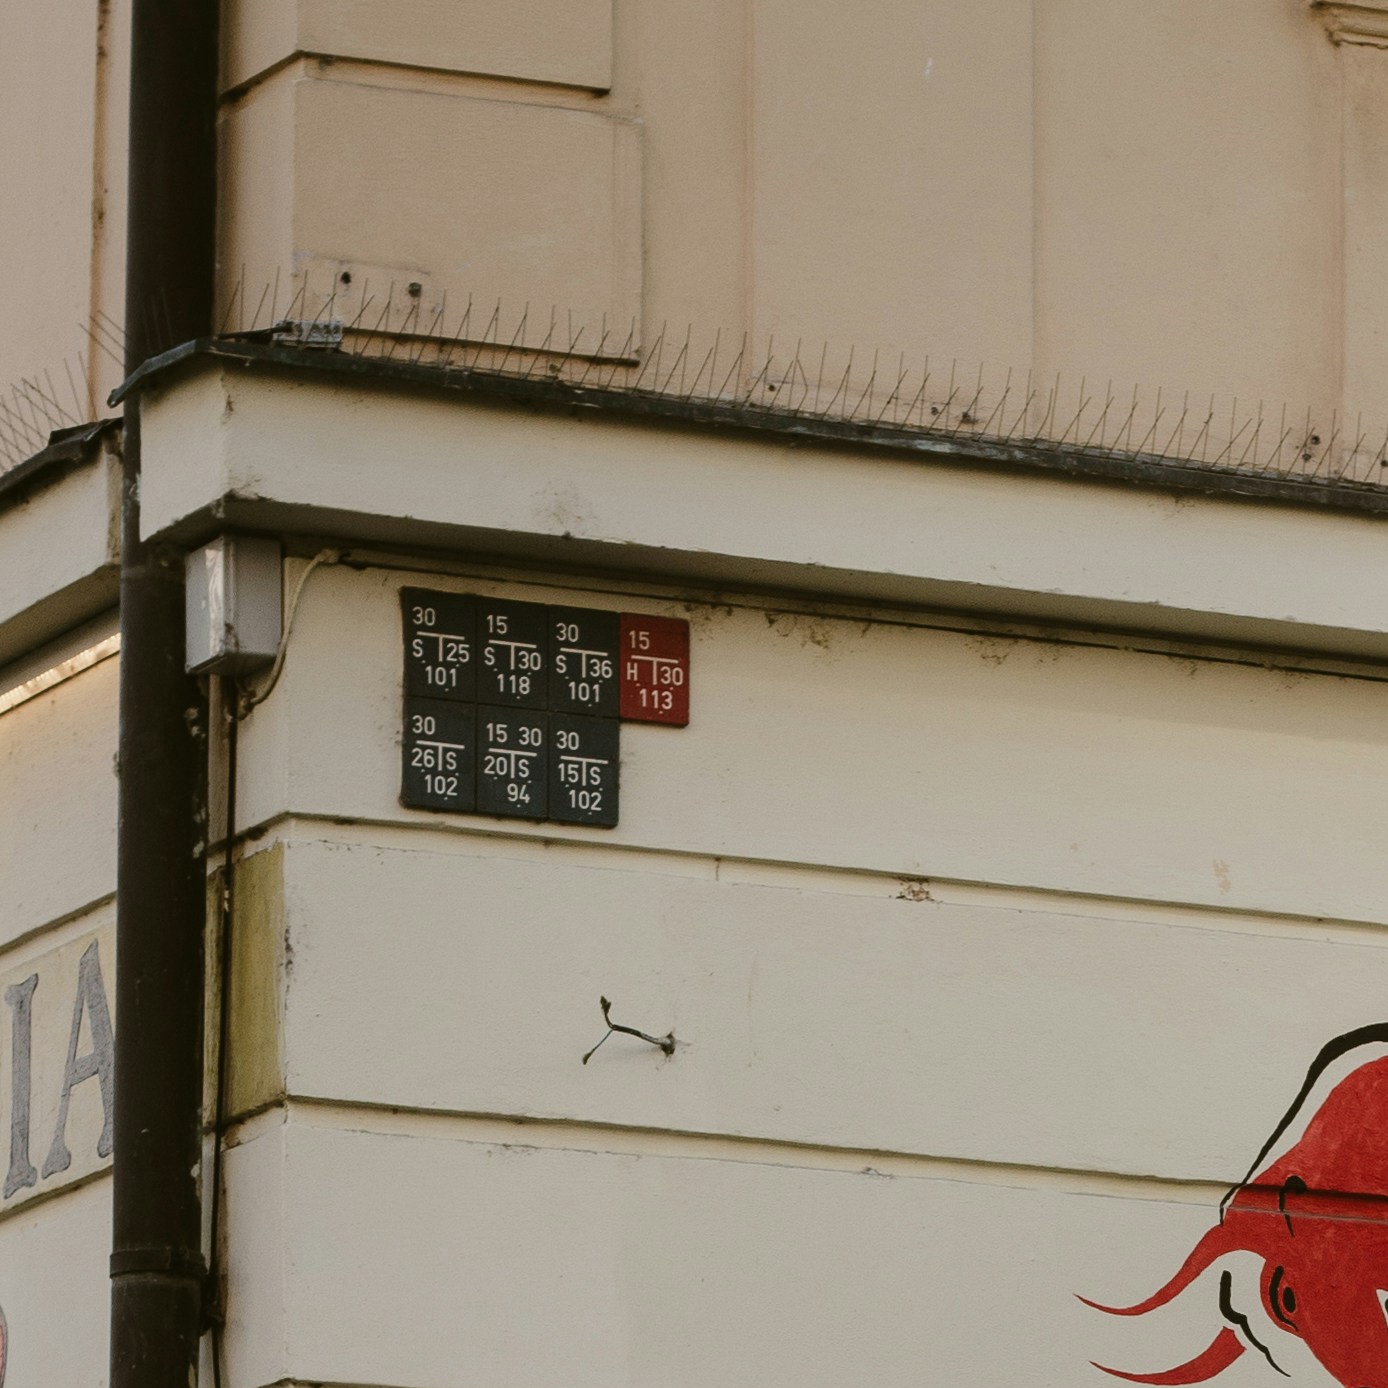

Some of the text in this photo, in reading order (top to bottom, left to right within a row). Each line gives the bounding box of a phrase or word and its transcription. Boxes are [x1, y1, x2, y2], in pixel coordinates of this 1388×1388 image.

[412, 606, 435, 625] 30
[486, 615, 507, 634] 15
[556, 623, 579, 642] 30
[629, 631, 649, 649] 15
[412, 640, 470, 662] S 25
[484, 648, 541, 670] S 30
[425, 665, 456, 686] 101
[556, 656, 612, 678] S 36
[627, 663, 683, 686] H 30
[497, 673, 530, 694] 118
[568, 682, 600, 702] 101
[639, 689, 673, 709] 113
[412, 716, 435, 735] 30
[486, 723, 541, 746] 15 30
[556, 731, 579, 750] 30
[411, 748, 457, 770] 26 S
[484, 756, 529, 777] 20 S
[557, 763, 600, 785] 15 S
[425, 775, 458, 796] 102
[507, 784, 530, 803] 94
[568, 790, 601, 811] 102
